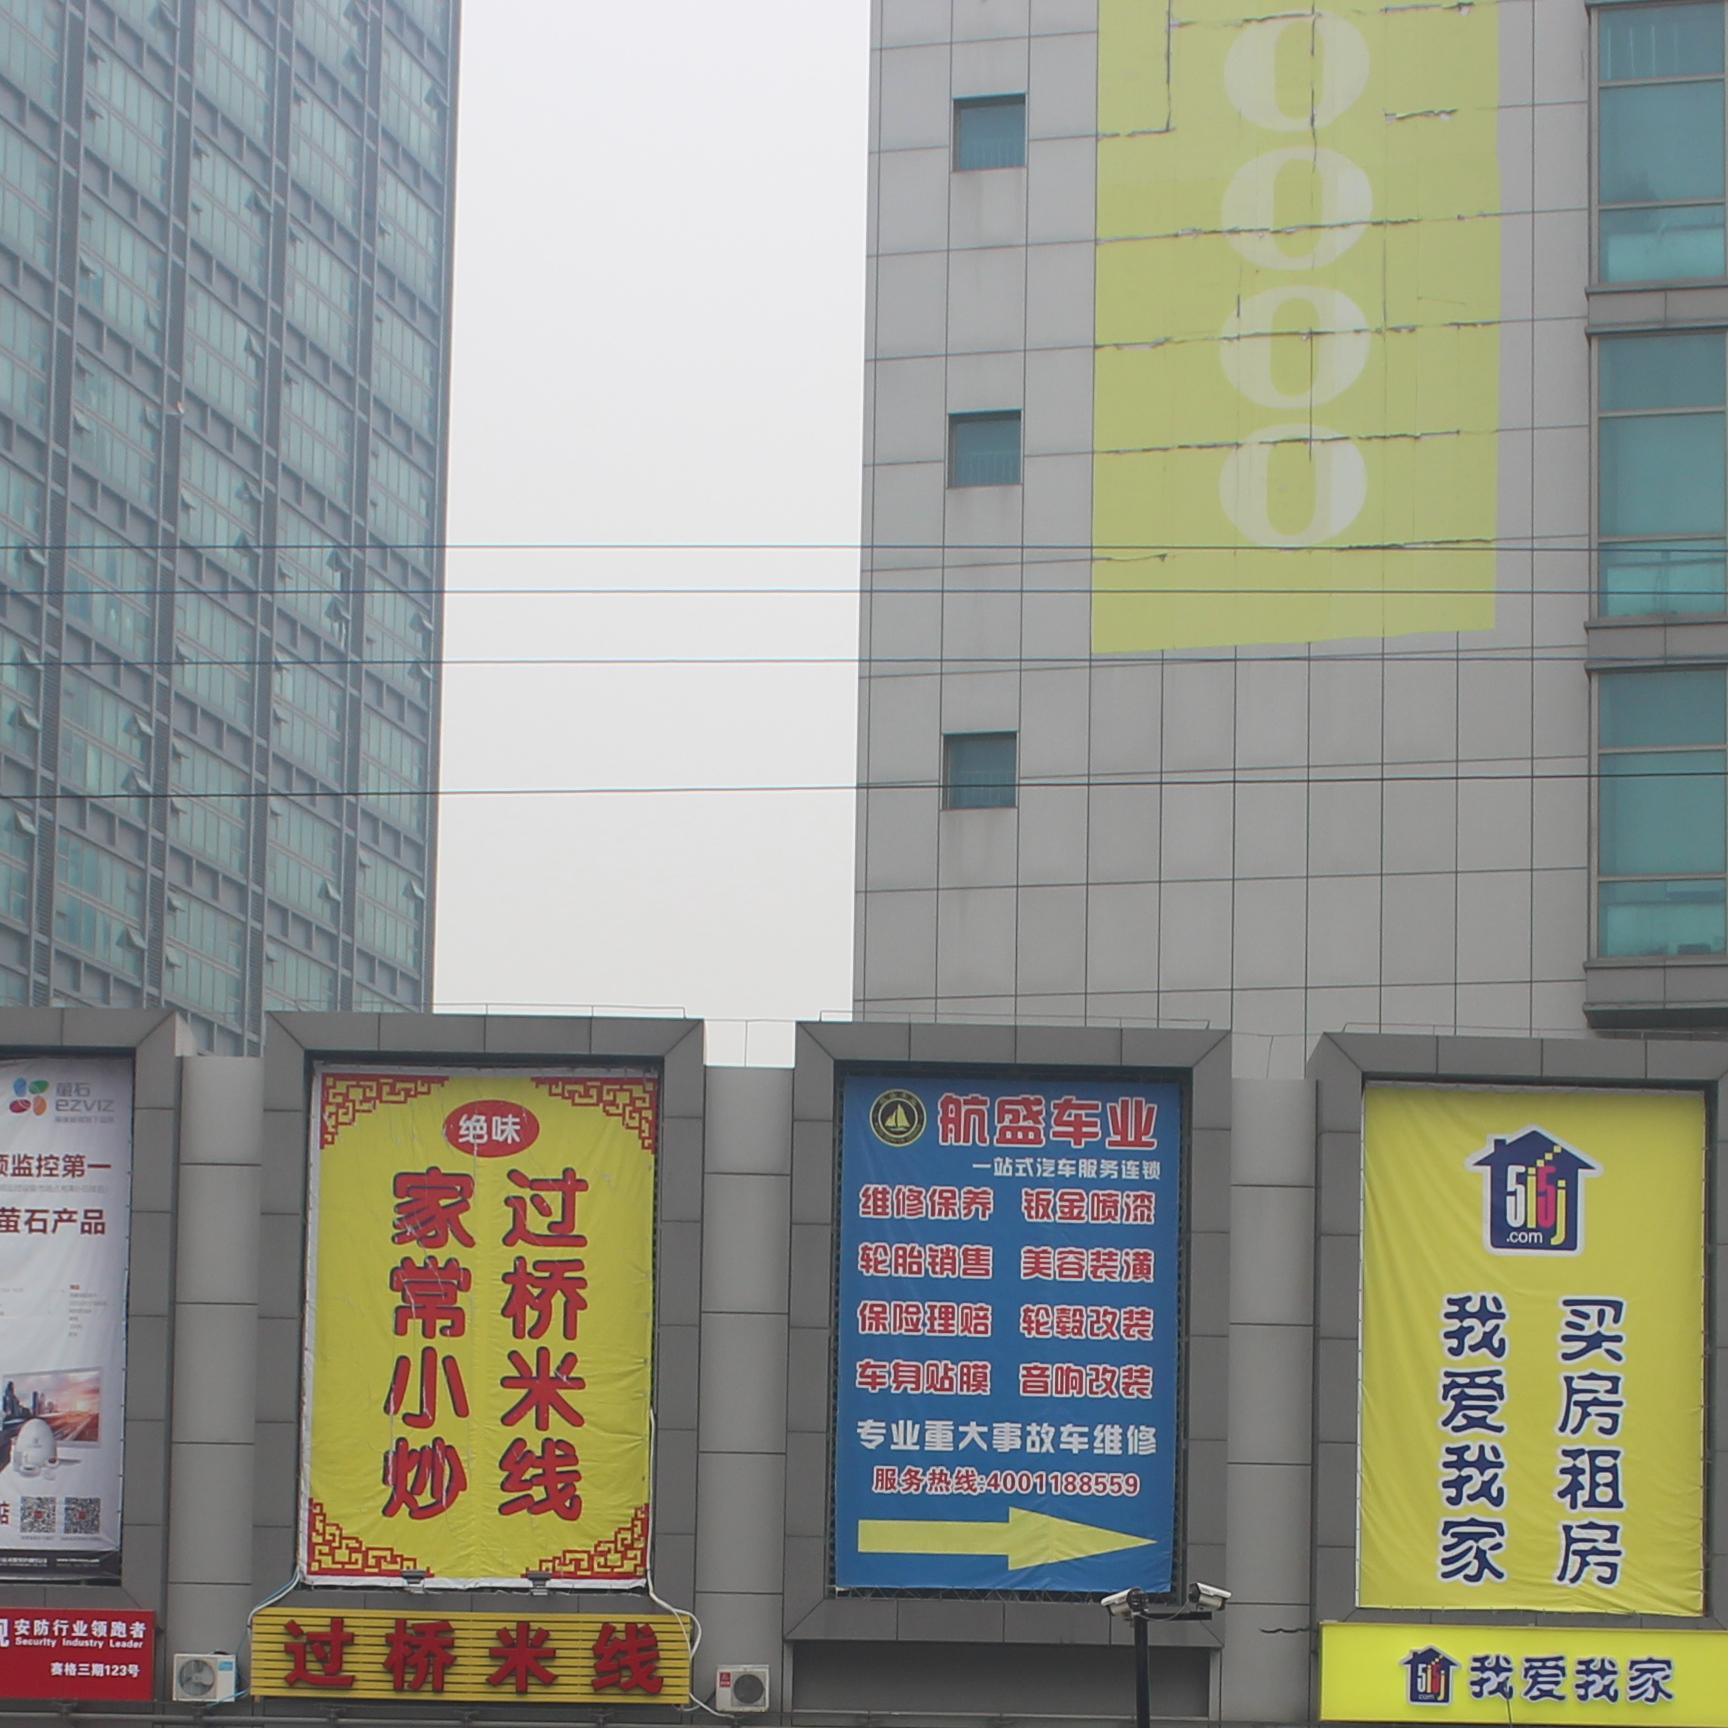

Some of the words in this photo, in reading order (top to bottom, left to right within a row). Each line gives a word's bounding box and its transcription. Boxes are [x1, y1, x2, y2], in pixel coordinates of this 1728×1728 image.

[457, 1112, 521, 1146] 绝味
[938, 1092, 1158, 1151] 航盛车业
[972, 1157, 1161, 1181] 一站式汽车服务连锁
[859, 1184, 995, 1222] 维修保养
[1021, 1187, 1156, 1226] 钣金喷漆
[1506, 1231, 1543, 1244] .com
[857, 1243, 994, 1280] 轮胎销售
[1021, 1246, 1155, 1283] 美容装潢
[857, 1300, 993, 1338] 保险理赔
[1020, 1304, 1154, 1341] 轮毂改装
[382, 1166, 475, 1520] 家常小炒
[498, 1166, 589, 1523] 过桥米线
[855, 1359, 992, 1396] 车身贴膜
[1019, 1362, 1153, 1399] 音响改装
[856, 1419, 1158, 1456] 专业重大事故车维修
[1438, 1294, 1507, 1585] 我爱我家
[1555, 1296, 1625, 1586] 买房租房
[14, 1619, 147, 1638] 安防行业领跑者
[15, 1637, 57, 1648] Security
[62, 1638, 103, 1649] Industry
[109, 1639, 143, 1649] Leader
[50, 1662, 141, 1678] 赛格三期123号
[283, 1616, 665, 1694] 过桥米线
[1469, 1654, 1674, 1704] 我爱我家
